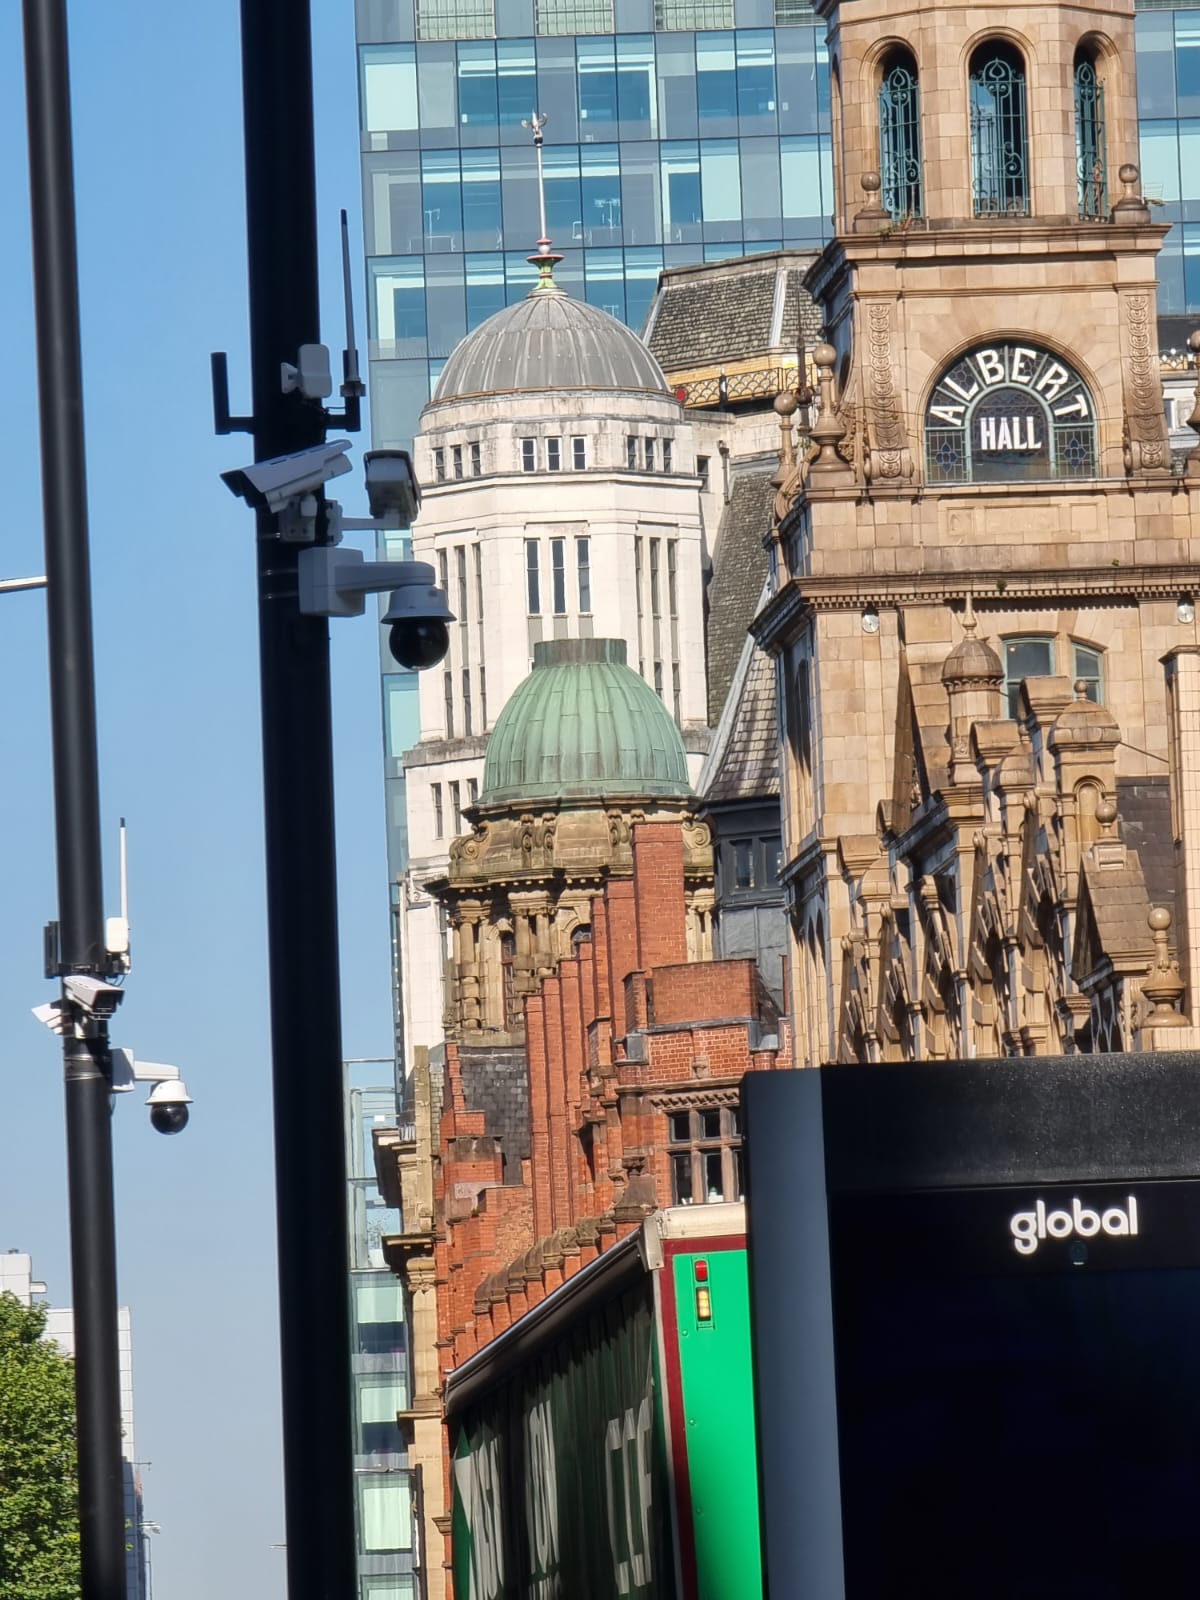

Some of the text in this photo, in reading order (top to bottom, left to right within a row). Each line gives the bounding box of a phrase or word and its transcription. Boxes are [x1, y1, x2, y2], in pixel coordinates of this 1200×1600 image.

[930, 347, 1089, 426] ALBERT
[980, 416, 1042, 450] HALL
[1010, 1195, 1139, 1255] global
